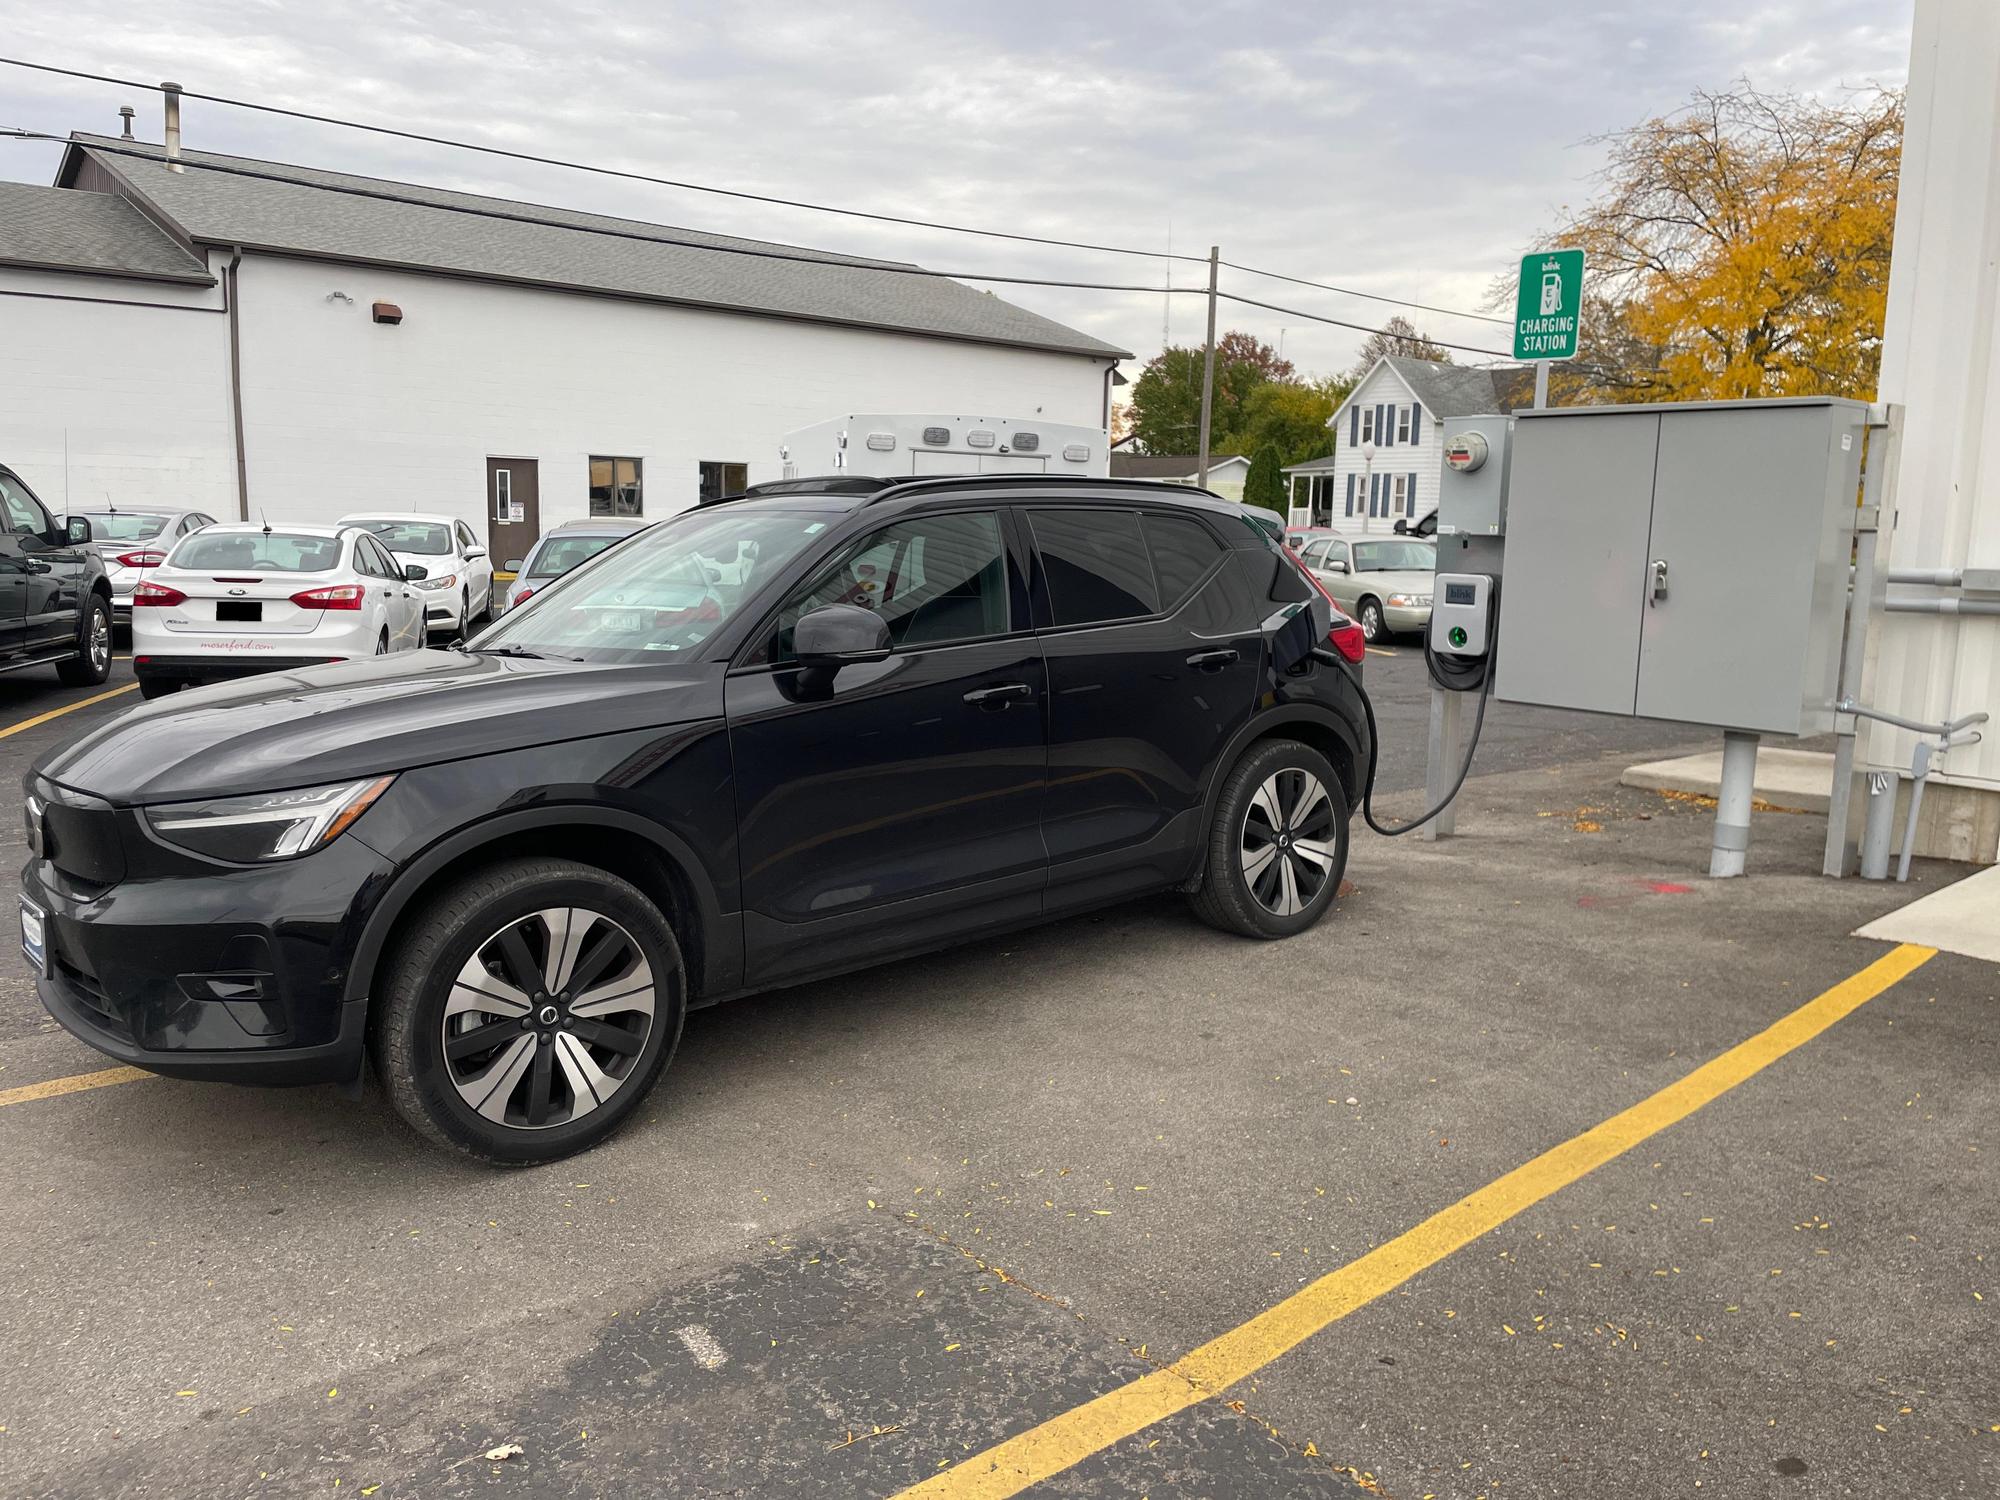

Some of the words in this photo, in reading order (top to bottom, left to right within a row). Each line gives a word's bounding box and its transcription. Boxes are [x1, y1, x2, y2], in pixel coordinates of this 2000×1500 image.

[1520, 316, 1574, 335] CHARGING
[1523, 334, 1567, 352] STATION
[1450, 587, 1472, 600] blink
[200, 639, 276, 652] moserford.com
